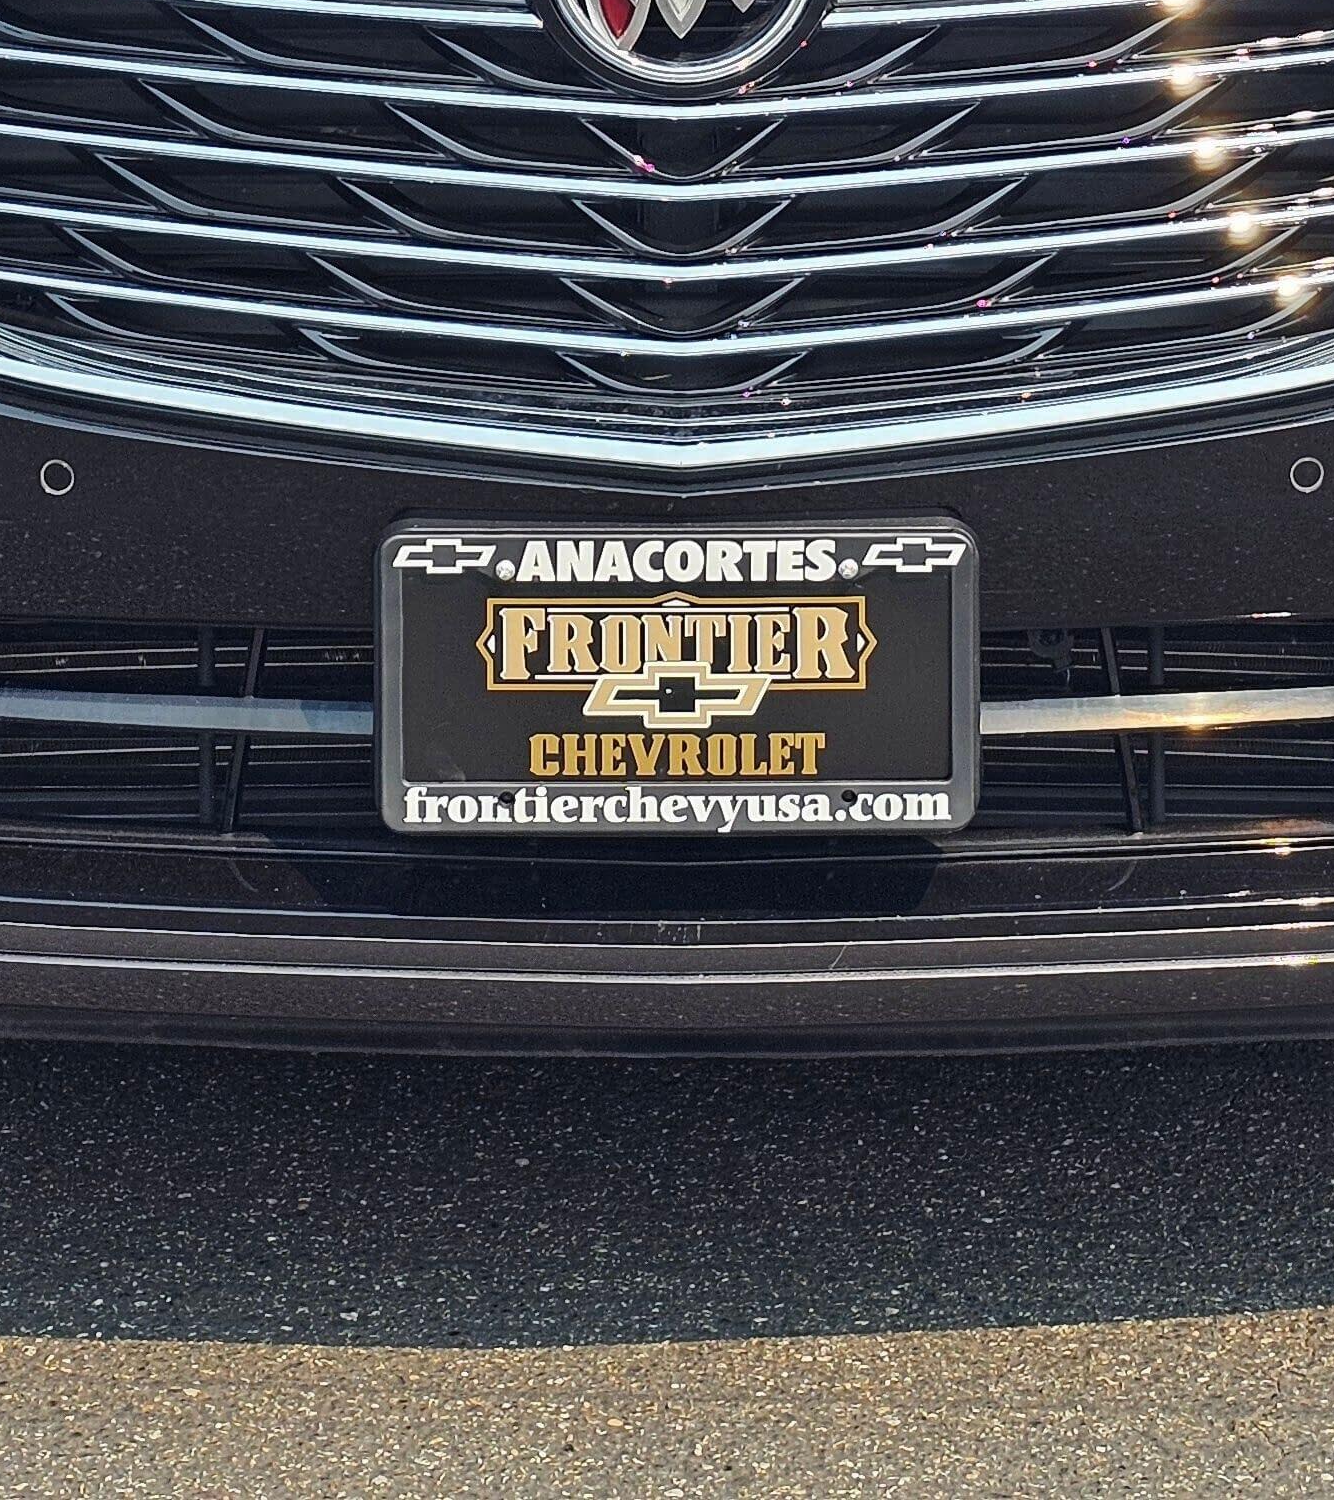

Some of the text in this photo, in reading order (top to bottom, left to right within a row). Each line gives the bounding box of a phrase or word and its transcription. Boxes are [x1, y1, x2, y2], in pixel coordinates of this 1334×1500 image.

[515, 538, 838, 583] ANACORTES
[498, 606, 856, 680] FRONTIER
[528, 732, 826, 777] CHEVROLET
[403, 785, 952, 834] frontierchevyusa.com
